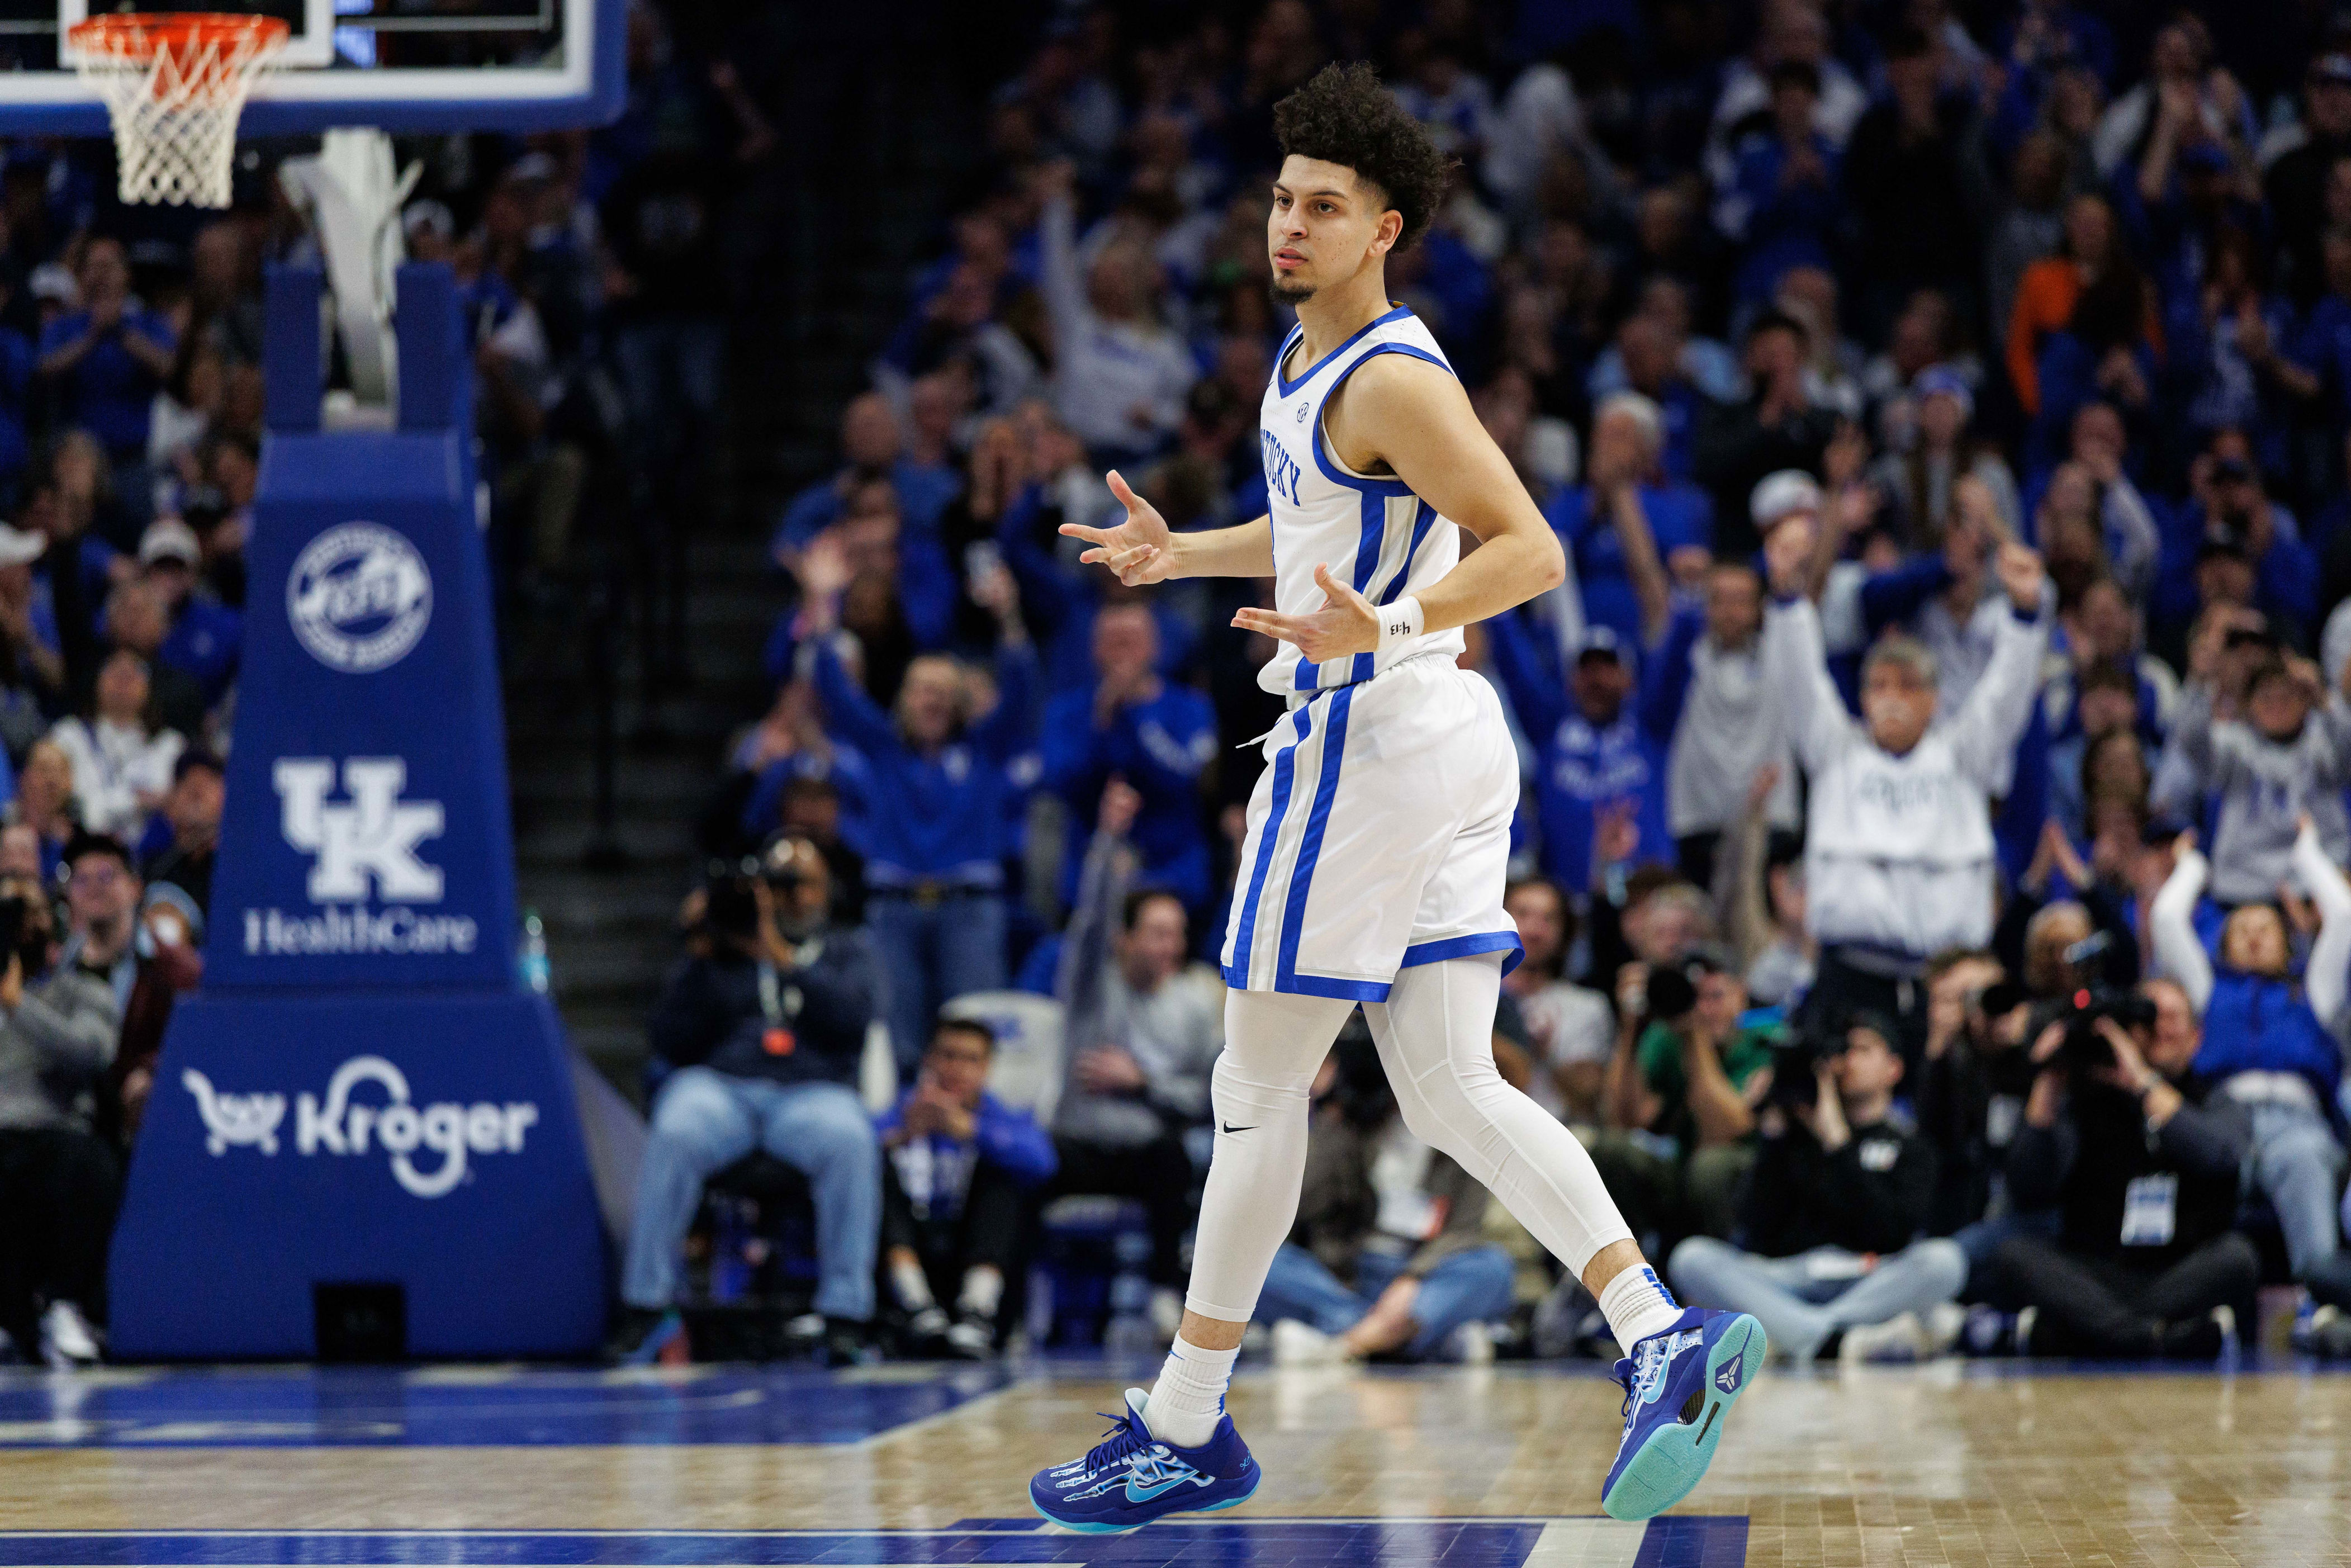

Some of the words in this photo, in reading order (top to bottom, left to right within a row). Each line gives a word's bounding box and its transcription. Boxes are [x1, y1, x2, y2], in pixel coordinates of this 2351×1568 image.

[274, 758, 444, 901] UK
[244, 906, 476, 954] HealthCare
[296, 1056, 537, 1196] Kroger
